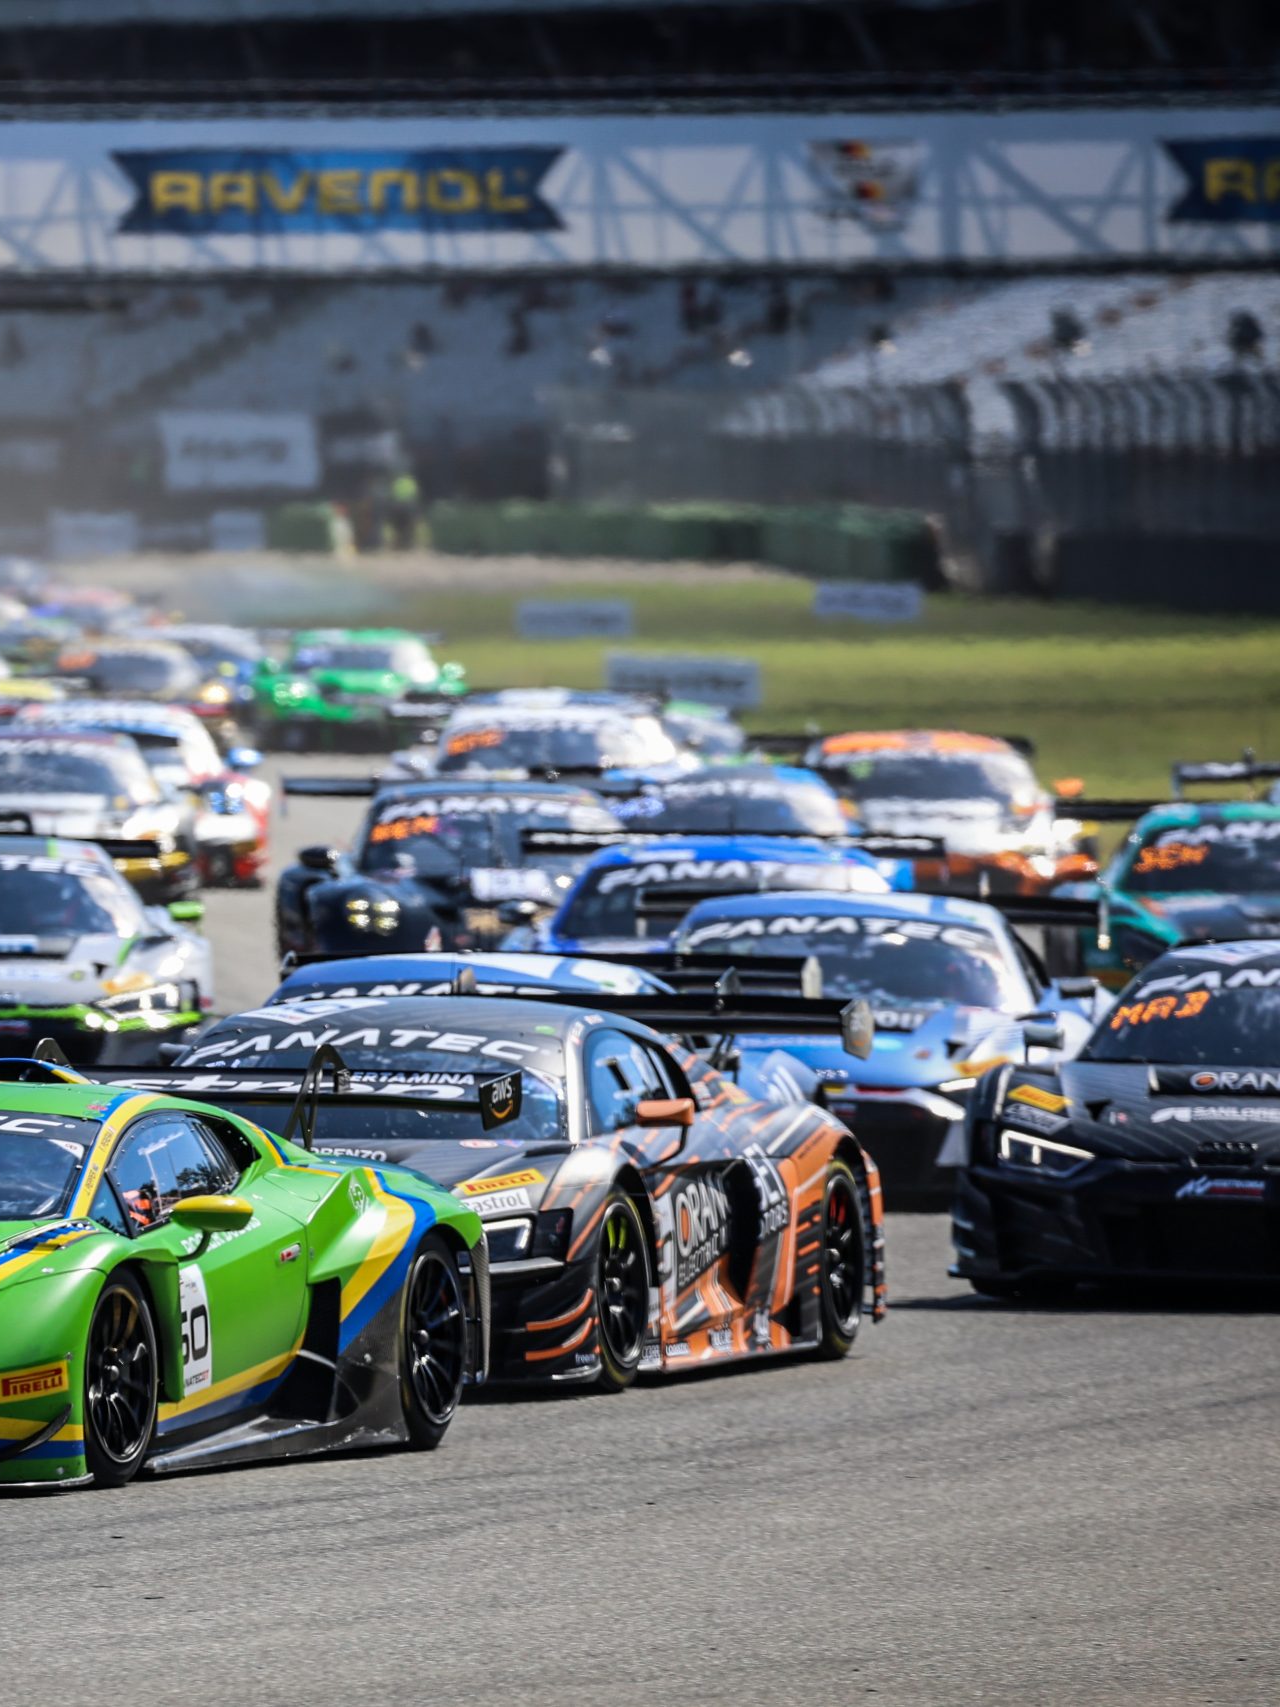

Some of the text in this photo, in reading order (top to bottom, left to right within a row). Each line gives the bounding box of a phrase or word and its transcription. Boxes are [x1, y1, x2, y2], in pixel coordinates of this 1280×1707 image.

[149, 169, 530, 214] RAVENOL
[687, 916, 993, 948] FANATEC
[180, 1027, 539, 1067] FANATEC
[342, 1072, 476, 1085] ERTAMINA
[491, 1078, 513, 1101] aws
[309, 1146, 388, 1163] ORENZO
[1, 1367, 63, 1397] PIRELLI
